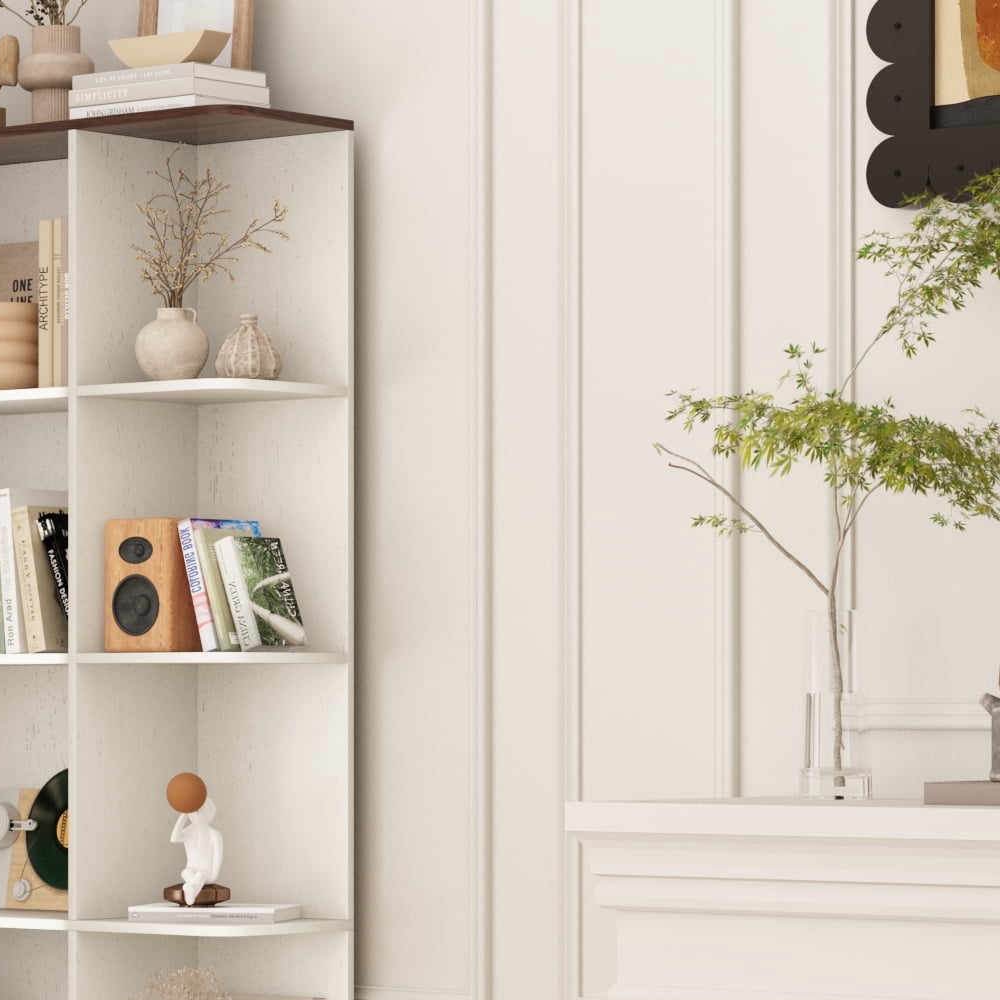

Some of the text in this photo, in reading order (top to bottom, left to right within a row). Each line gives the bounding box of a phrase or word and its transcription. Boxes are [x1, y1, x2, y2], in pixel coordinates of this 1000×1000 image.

[75, 88, 129, 103] SIMPLICITY
[12, 278, 33, 292] ONE
[39, 266, 49, 331] ARCHITYPE
[48, 549, 64, 587] FASHION
[5, 599, 14, 622] Arad
[7, 626, 15, 646] Ron
